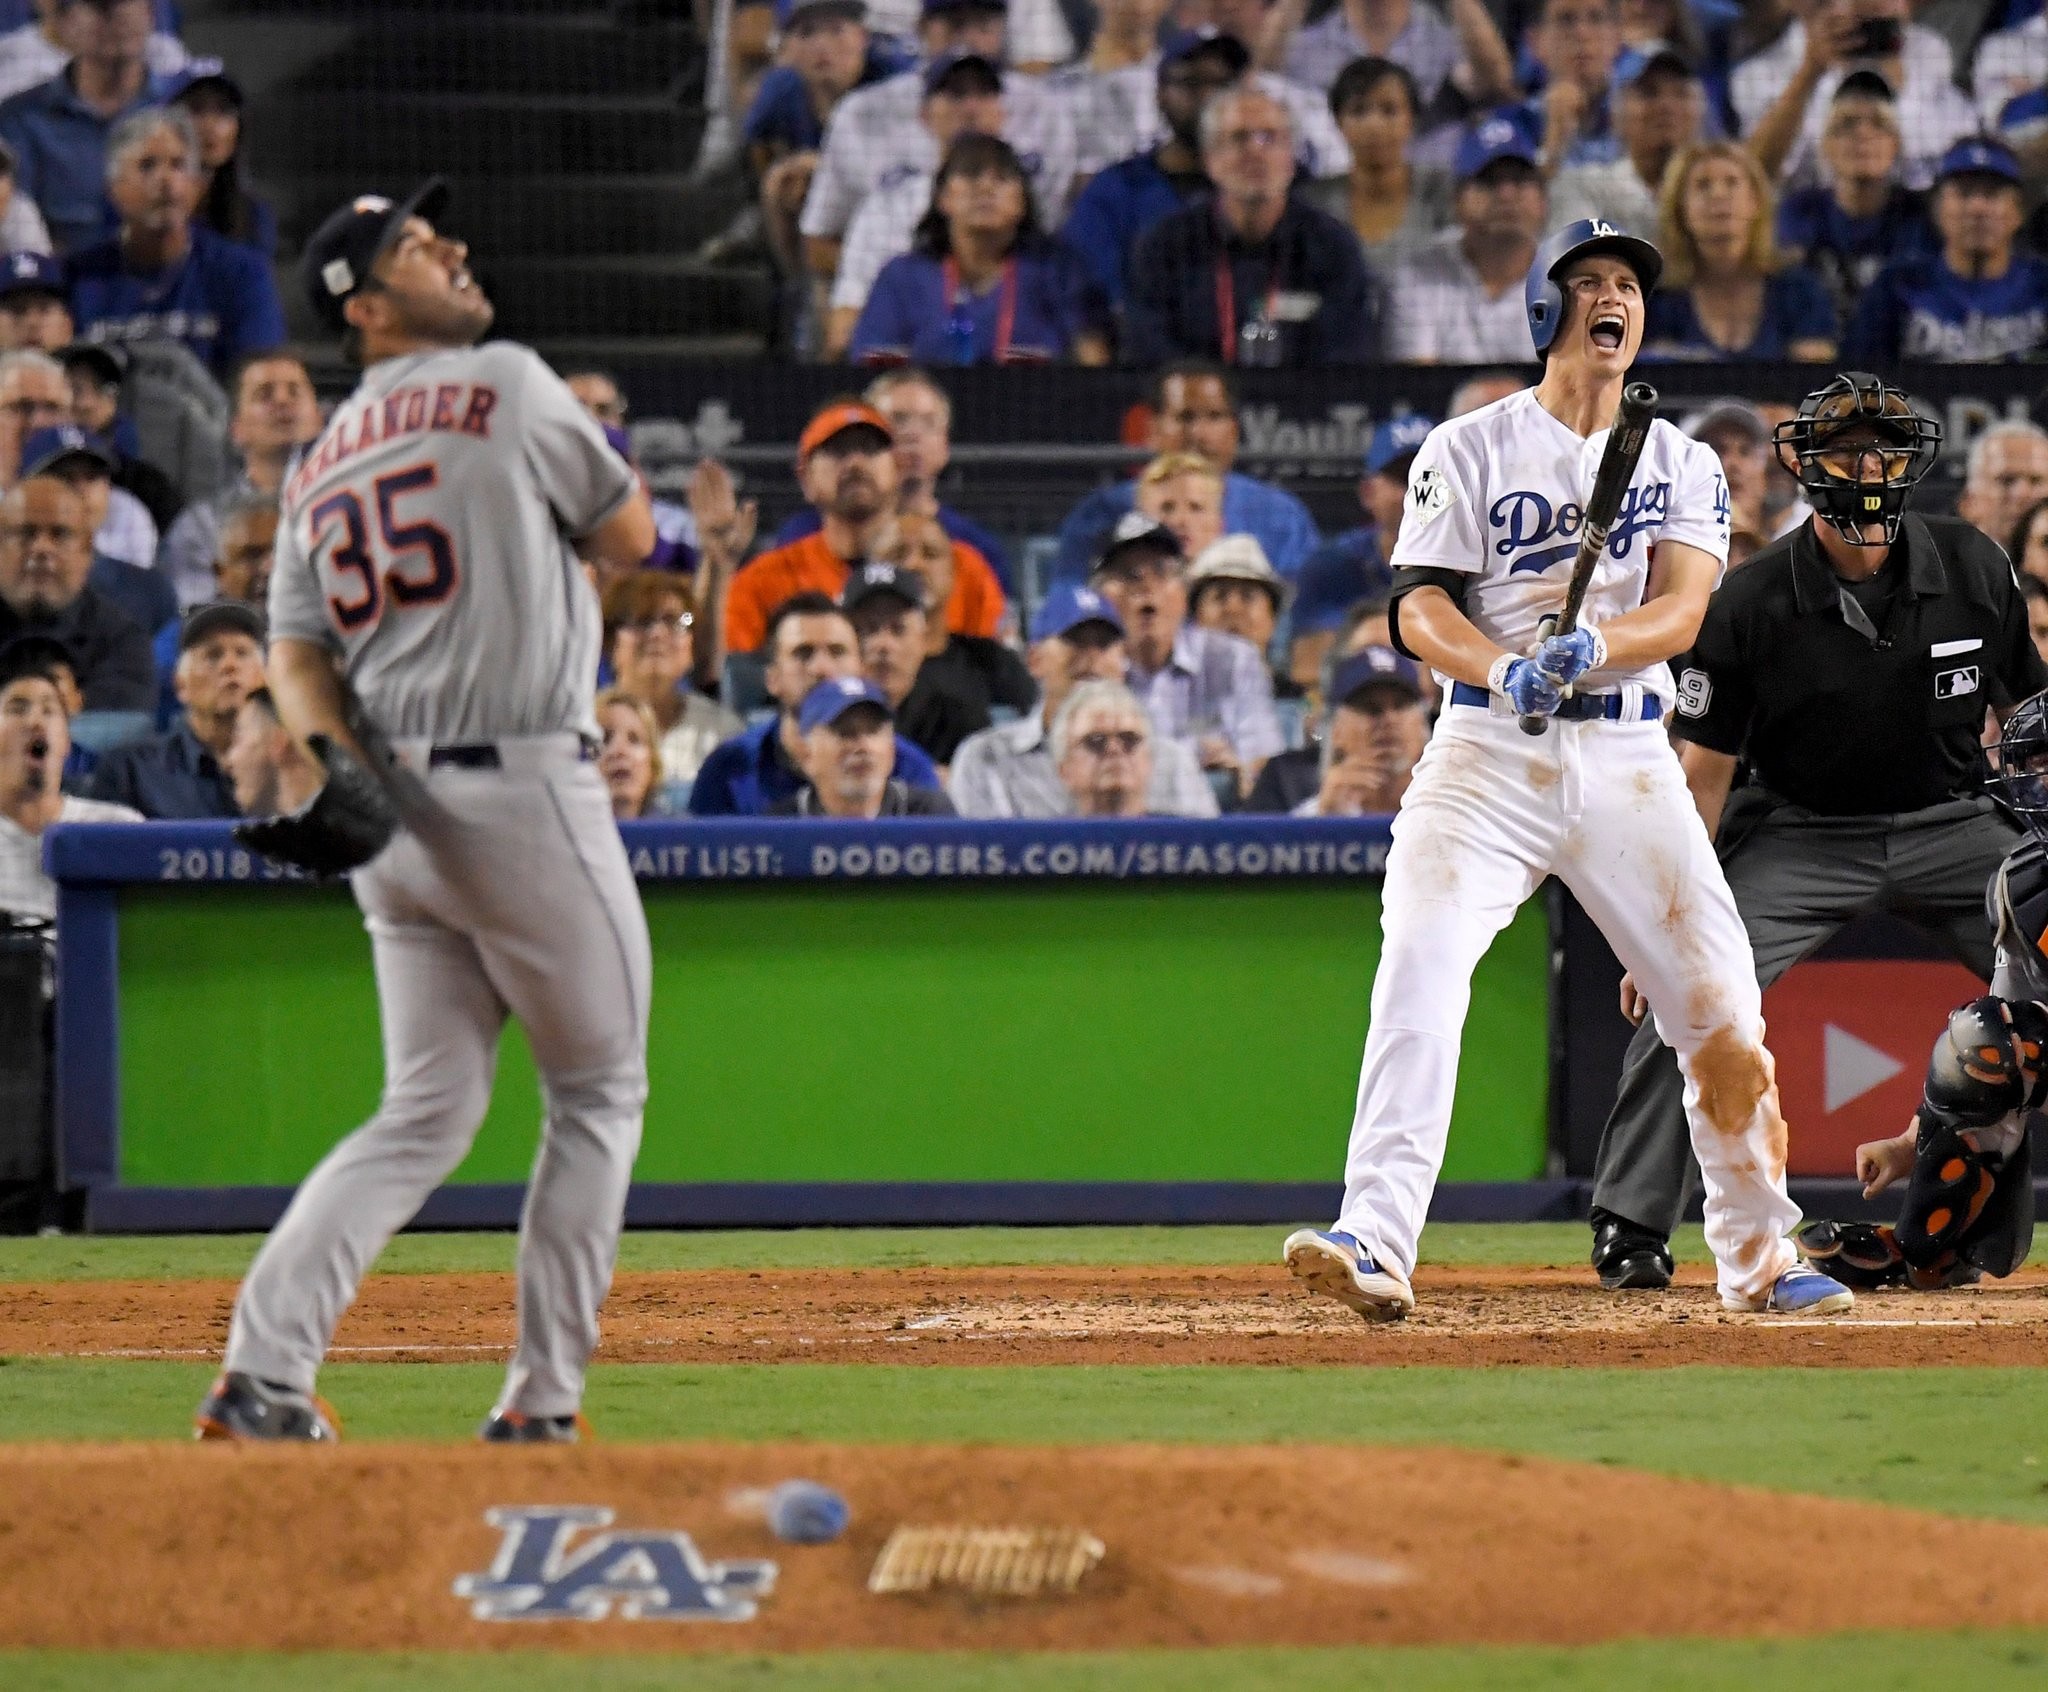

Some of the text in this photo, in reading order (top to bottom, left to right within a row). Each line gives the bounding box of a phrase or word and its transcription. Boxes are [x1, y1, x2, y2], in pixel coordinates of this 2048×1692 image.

[1588, 217, 1619, 237] LA
[286, 382, 498, 510] LANDER
[309, 459, 460, 635] 35
[1489, 482, 1670, 560] Doges
[1676, 668, 1714, 719] 9
[158, 848, 252, 880] 2018
[630, 846, 689, 877] AIT
[701, 846, 783, 877] LIST:
[453, 1504, 779, 1624] LA
